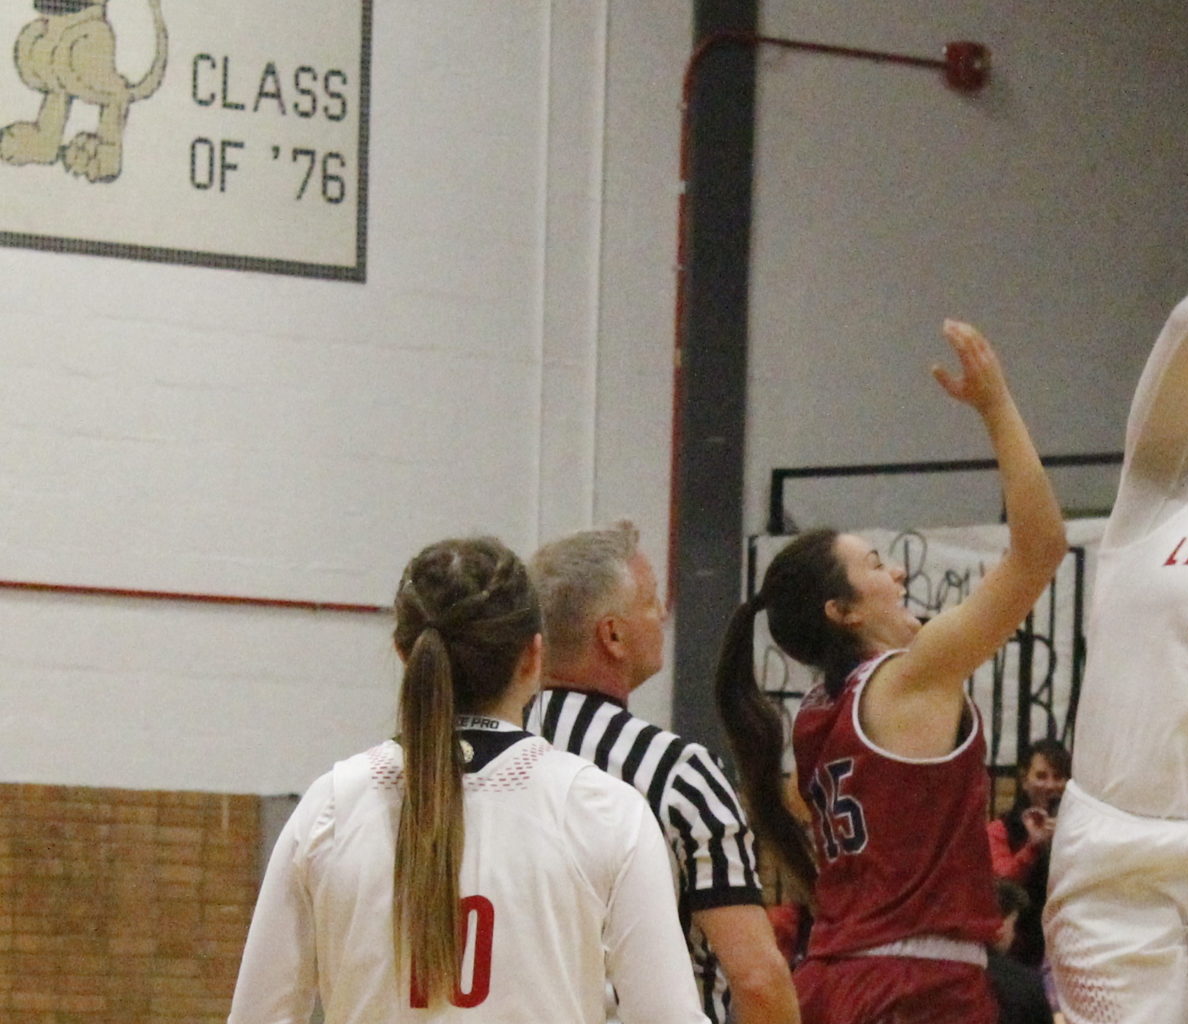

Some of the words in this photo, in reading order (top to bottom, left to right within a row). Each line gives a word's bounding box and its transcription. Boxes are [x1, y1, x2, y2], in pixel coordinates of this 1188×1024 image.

[192, 53, 347, 122] CLASS
[190, 136, 246, 192] OF
[271, 145, 346, 204] '76
[470, 719, 500, 730] PRO
[809, 757, 869, 864] 15
